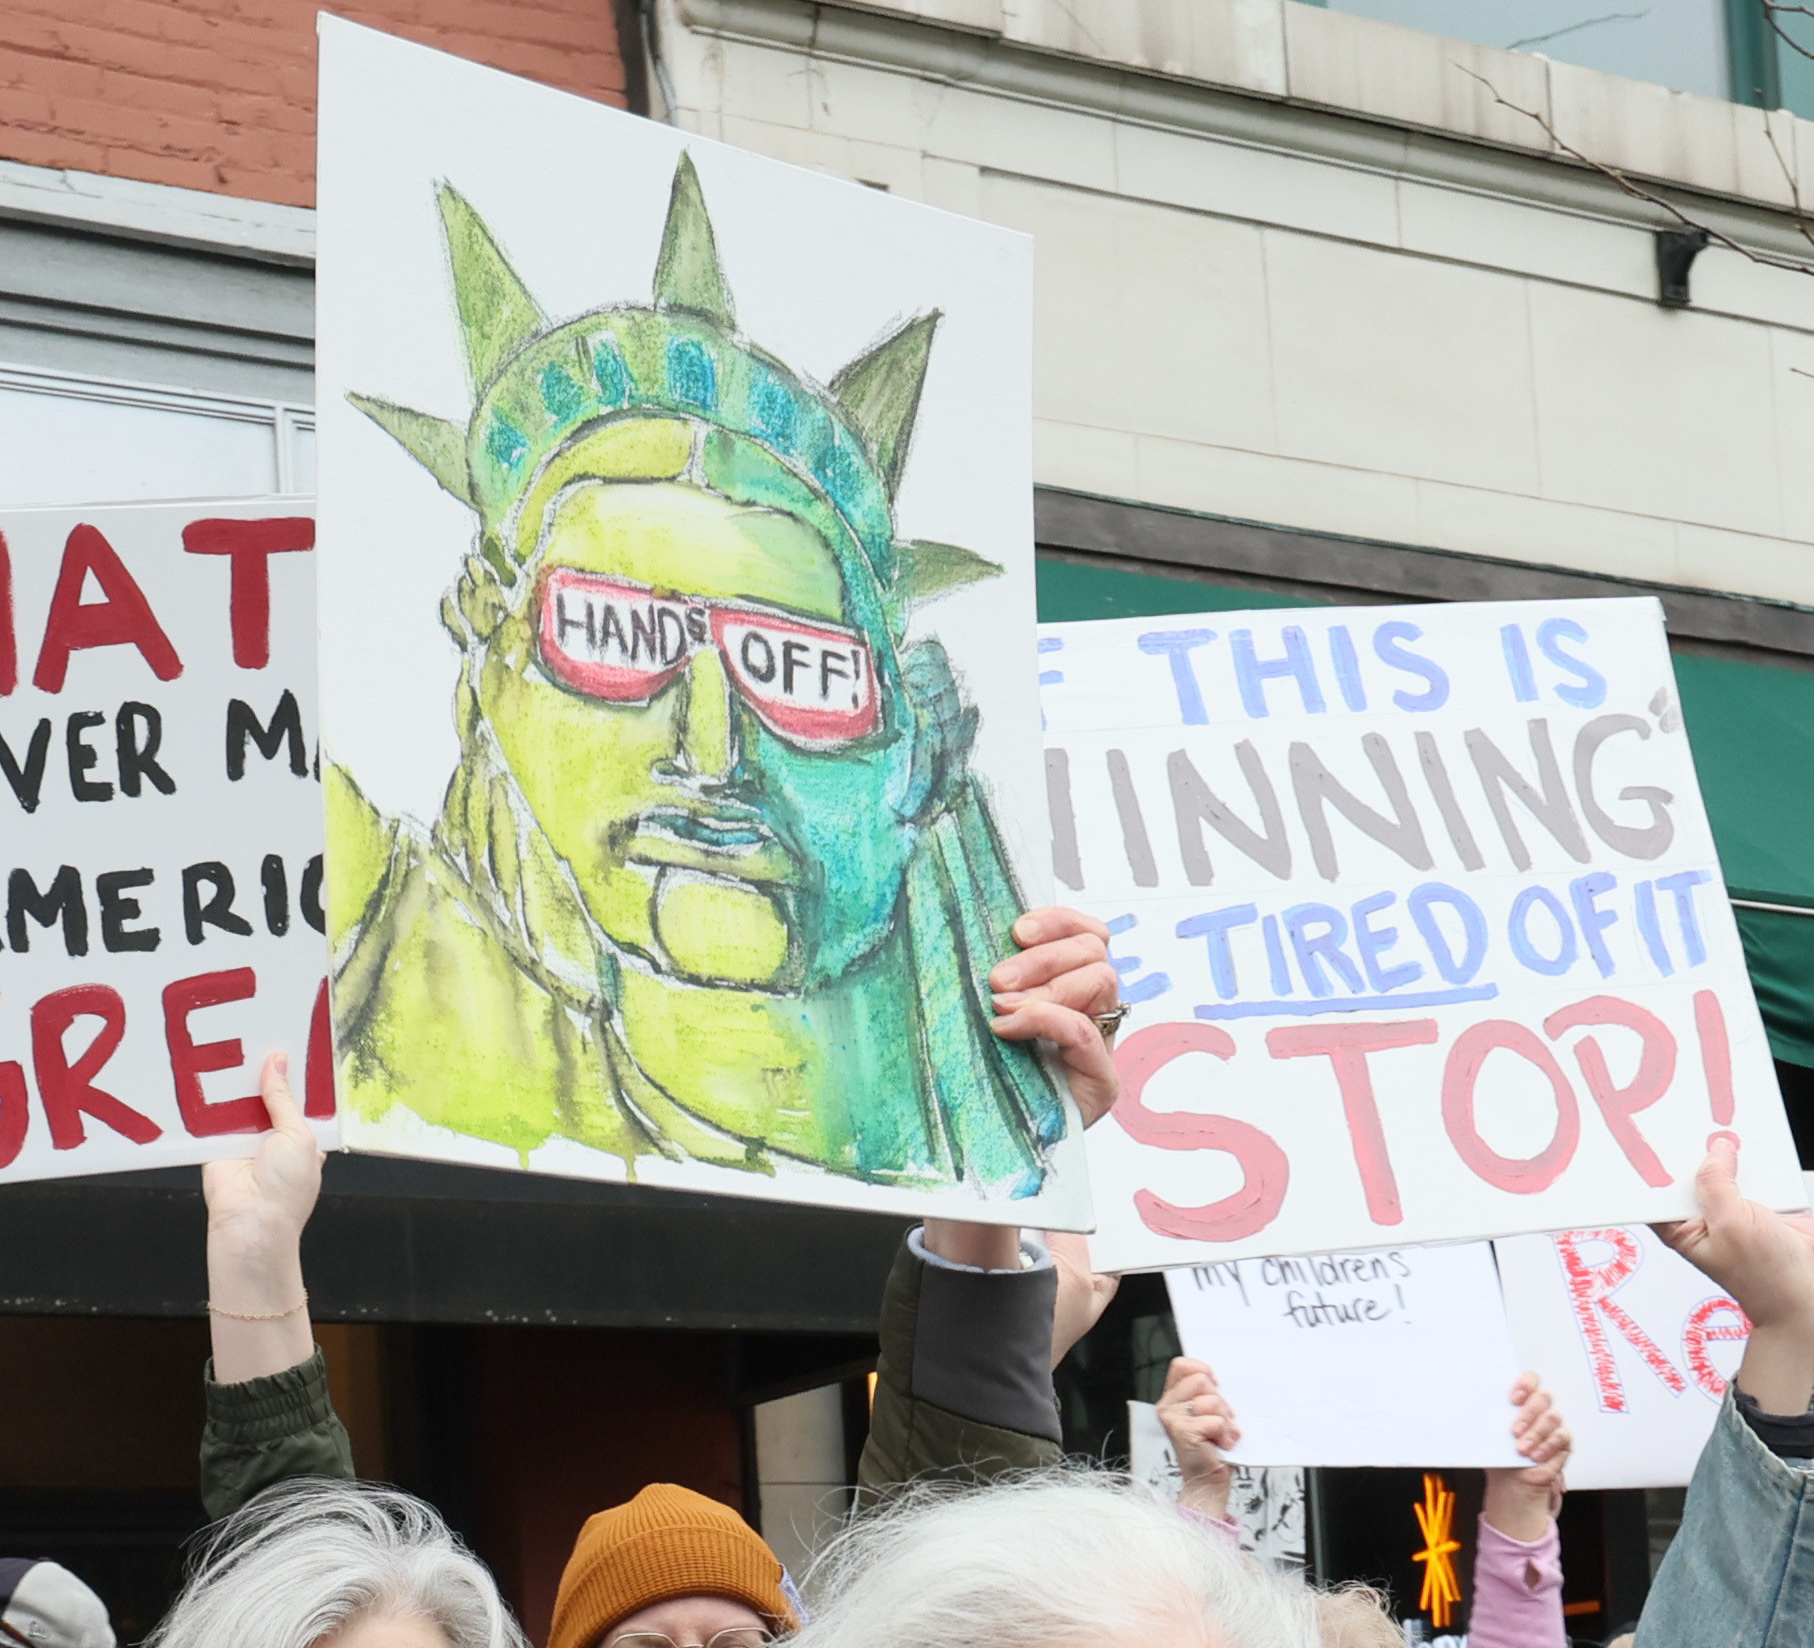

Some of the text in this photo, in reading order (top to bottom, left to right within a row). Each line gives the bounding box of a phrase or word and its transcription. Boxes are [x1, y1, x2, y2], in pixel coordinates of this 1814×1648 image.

[557, 592, 862, 710] HANDS OFF!
[1138, 622, 1450, 726] THIS
[1499, 617, 1608, 709] IS
[226, 689, 322, 782] M
[1176, 882, 1488, 998] TIRED
[1508, 869, 1619, 979] OF
[1636, 868, 1713, 978] IT
[1109, 989, 1742, 1243] STOP!
[1191, 1259, 1251, 1308] my
